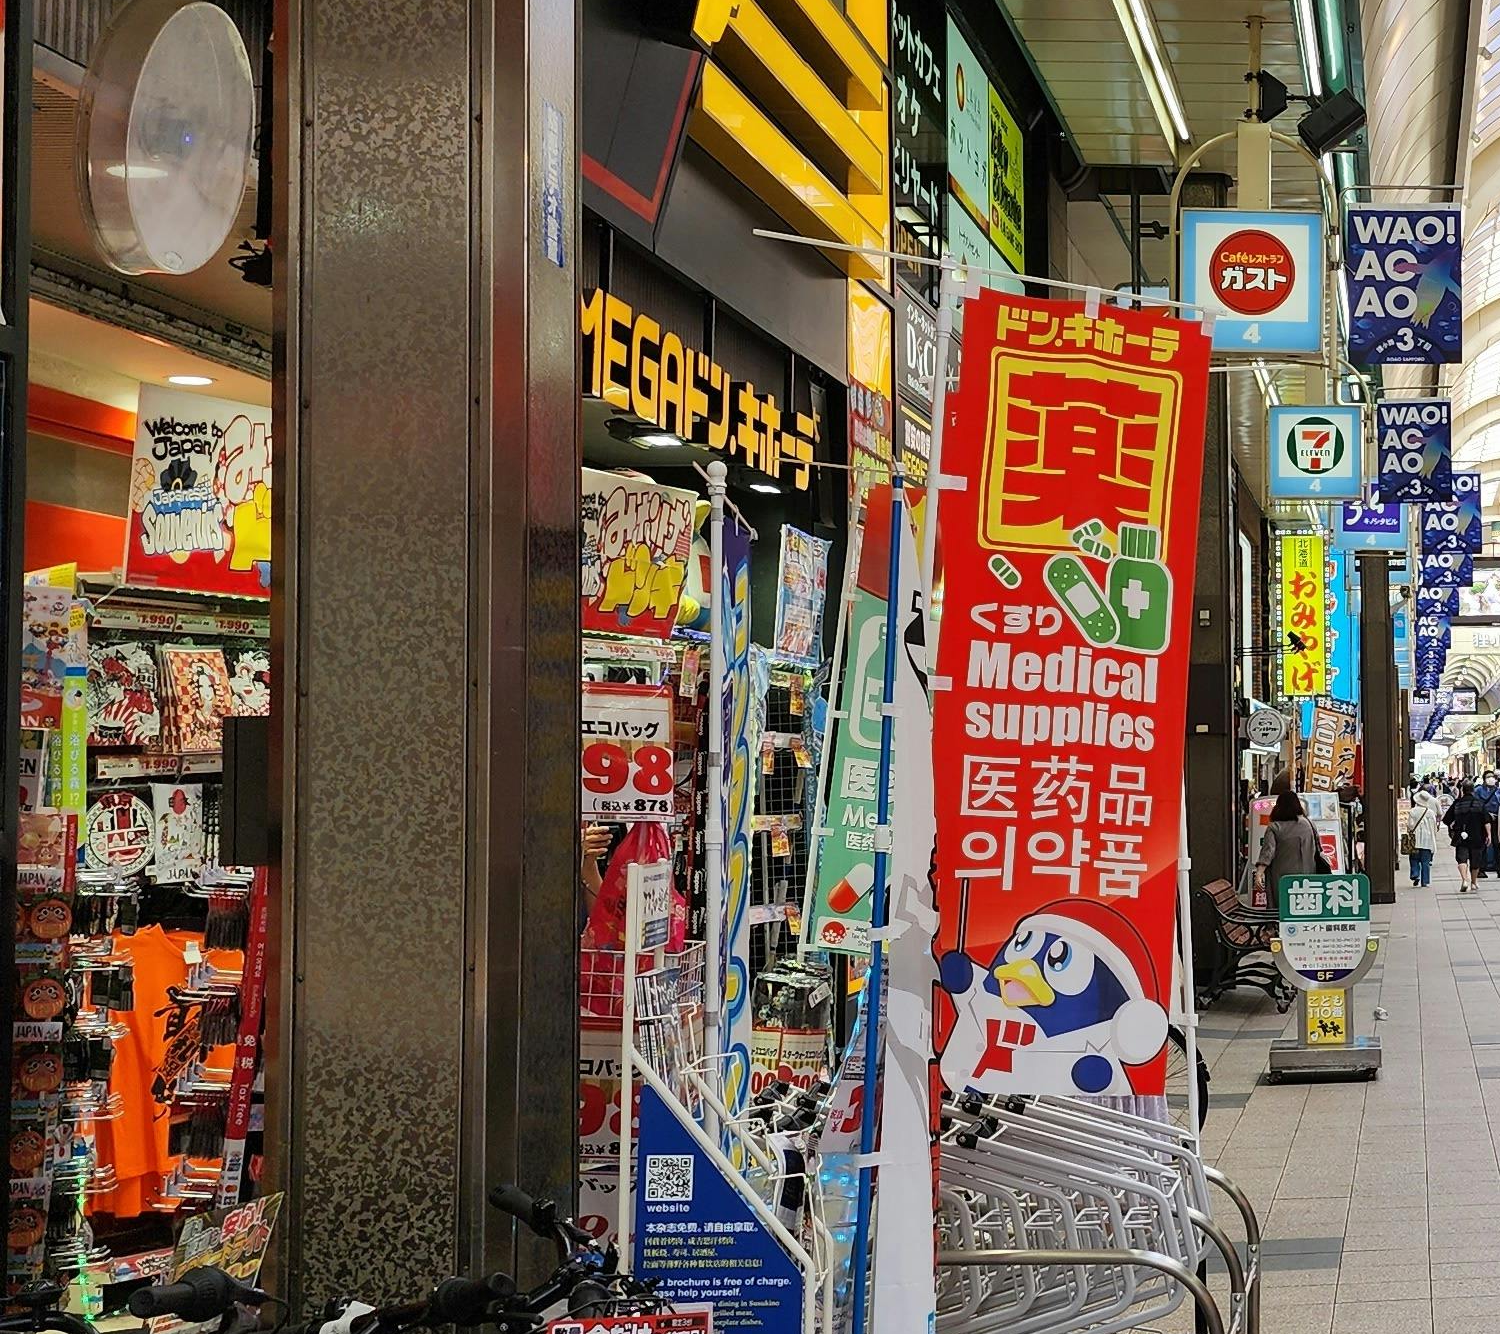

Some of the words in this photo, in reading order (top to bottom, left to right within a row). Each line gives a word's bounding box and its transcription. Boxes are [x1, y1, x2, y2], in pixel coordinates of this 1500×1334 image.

[1352, 215, 1456, 245] WAO!
[1219, 265, 1288, 292] ガスト
[1354, 287, 1419, 319] AO
[1242, 322, 1262, 344] 4
[1396, 326, 1415, 353] 3
[1380, 404, 1448, 427] WAO!
[144, 417, 208, 437] Welcome
[151, 438, 219, 463] Japan!
[1001, 369, 1170, 530] 薬
[1381, 453, 1425, 475] AO
[152, 485, 210, 507] Japanese
[1308, 478, 1323, 492] 4
[1409, 478, 1423, 496] 3
[141, 502, 225, 556] Souvenirs
[1425, 513, 1459, 532] AO
[1366, 534, 1377, 546] 4
[1446, 533, 1458, 549] 3
[1297, 538, 1309, 568] 北海道
[1425, 554, 1454, 568] AO
[1417, 587, 1443, 600] AO
[970, 601, 1064, 637] くすり
[1288, 570, 1322, 693] おみやげ
[967, 639, 1160, 705] Medical
[964, 701, 1157, 754] supplies
[1312, 712, 1339, 772] KOBE
[960, 754, 1154, 828] 医药品
[953, 829, 1150, 899] 의약품
[16, 870, 47, 887] JAPAN
[1287, 877, 1363, 916] 歯科
[1316, 970, 1336, 981] 5F
[1307, 994, 1344, 1008] こども
[1307, 1007, 1344, 1020] 110番
[14, 1023, 43, 1040] JAPAN
[241, 1033, 258, 1070] 免税
[646, 1203, 691, 1214] website
[666, 1277, 711, 1287] brochure
[712, 1277, 721, 1286] is
[723, 1277, 742, 1286] free
[744, 1276, 754, 1286] of
[756, 1276, 792, 1288] charge.
[677, 1288, 698, 1298] help
[700, 1287, 742, 1299] yourself.
